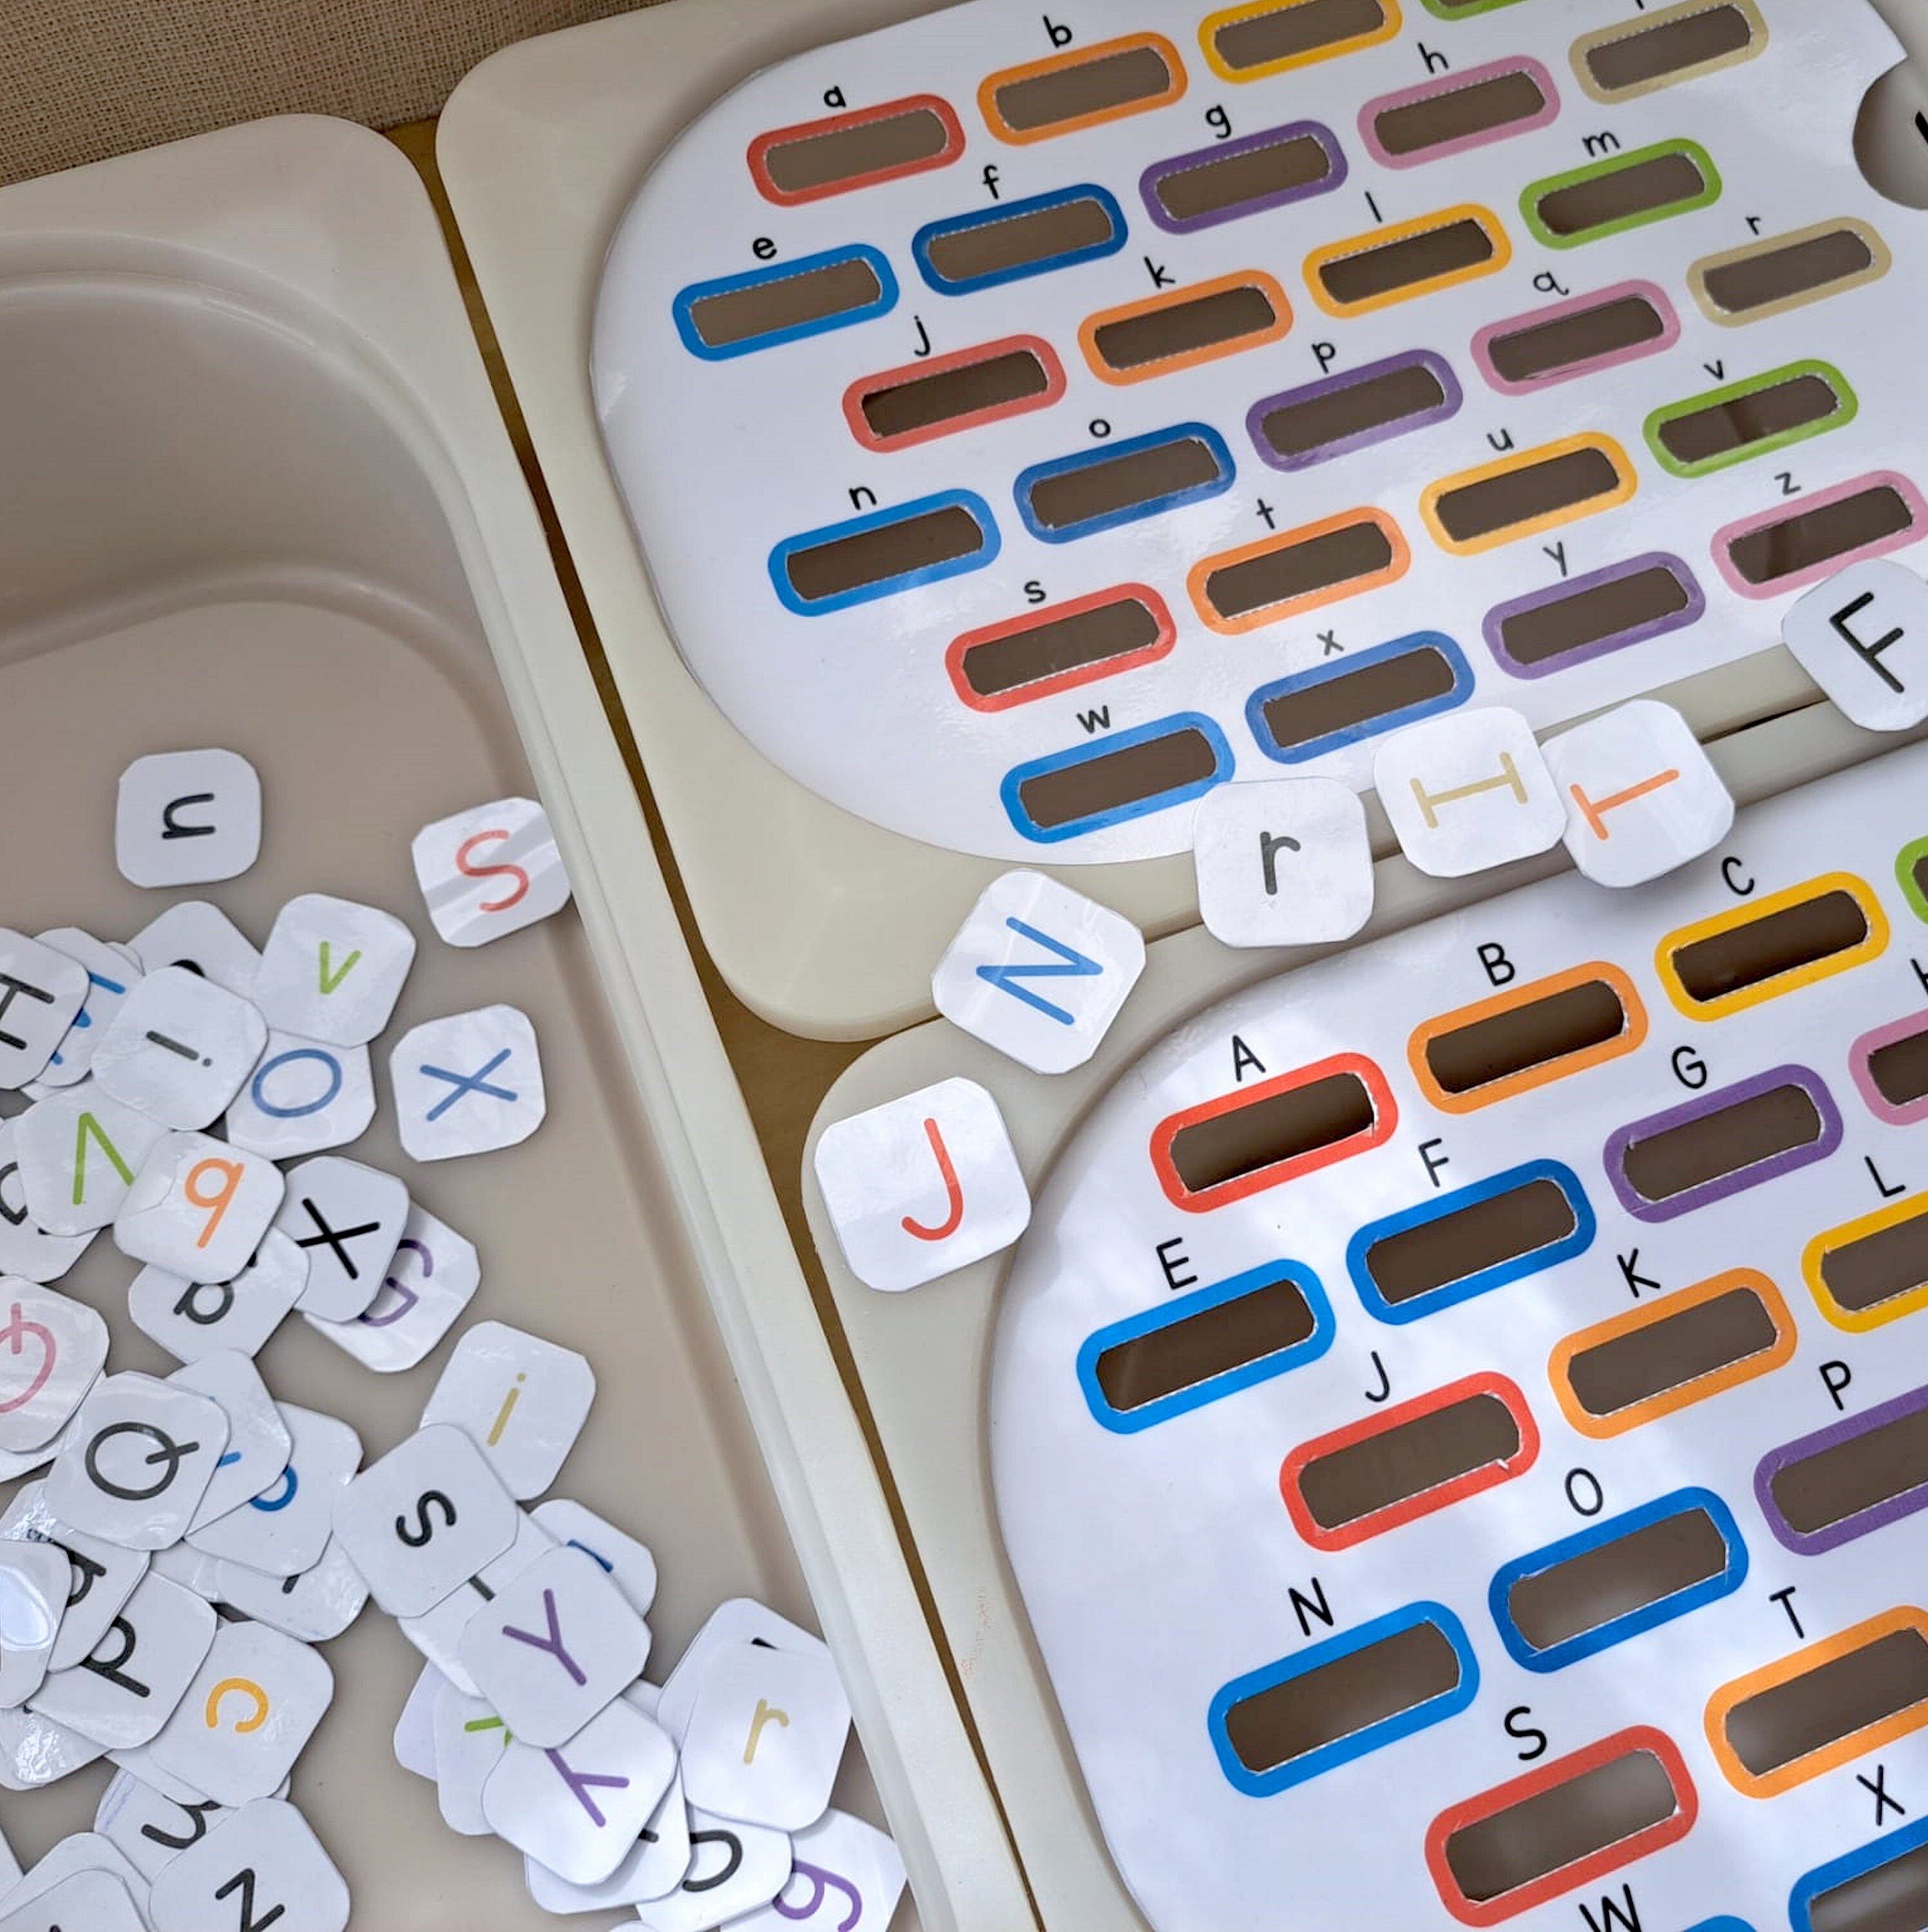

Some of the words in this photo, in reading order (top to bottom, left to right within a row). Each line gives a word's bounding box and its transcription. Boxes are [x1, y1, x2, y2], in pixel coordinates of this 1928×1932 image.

[1041, 14, 1073, 50] b
[1416, 41, 1450, 75] h
[822, 84, 847, 109] a
[1204, 103, 1233, 140] g
[1581, 131, 1621, 158] m
[981, 163, 1001, 201] f
[1744, 213, 1762, 236] r
[751, 236, 779, 261] e
[1142, 255, 1177, 290] k
[1532, 270, 1571, 296] q
[912, 314, 932, 358] j
[1310, 341, 1337, 375] p
[1703, 359, 1725, 381] v
[1088, 418, 1112, 439] o
[1486, 428, 1515, 452] u
[847, 486, 878, 511] n
[1773, 471, 1802, 496] z
[1256, 497, 1276, 531] t
[1542, 540, 1568, 578] y
[1023, 580, 1047, 605] s
[1316, 629, 1345, 656] x
[1828, 590, 1905, 694] F
[1075, 704, 1111, 735] w
[1569, 768, 1680, 842] T
[455, 829, 529, 913] S
[1259, 830, 1301, 896] r
[1720, 855, 1755, 897] C
[1475, 942, 1517, 988] B
[1231, 1034, 1267, 1083] A
[1670, 1045, 1708, 1090] G
[419, 1048, 518, 1122] X
[901, 1118, 965, 1242] J
[1417, 1137, 1450, 1188] F
[1863, 1155, 1907, 1199] L
[1155, 1236, 1199, 1289] E
[1616, 1247, 1662, 1300] K
[1364, 1350, 1391, 1404] J
[1817, 1359, 1853, 1412] P
[487, 1372, 527, 1448] i
[84, 1421, 201, 1502] Q
[1564, 1466, 1604, 1517] O
[1287, 1576, 1335, 1638] N
[1768, 1585, 1806, 1640] T
[501, 1587, 587, 1687] Y
[743, 1698, 791, 1766] r
[1502, 1705, 1548, 1762] S
[1855, 1763, 1907, 1828] X
[1578, 1882, 1643, 1932] W
